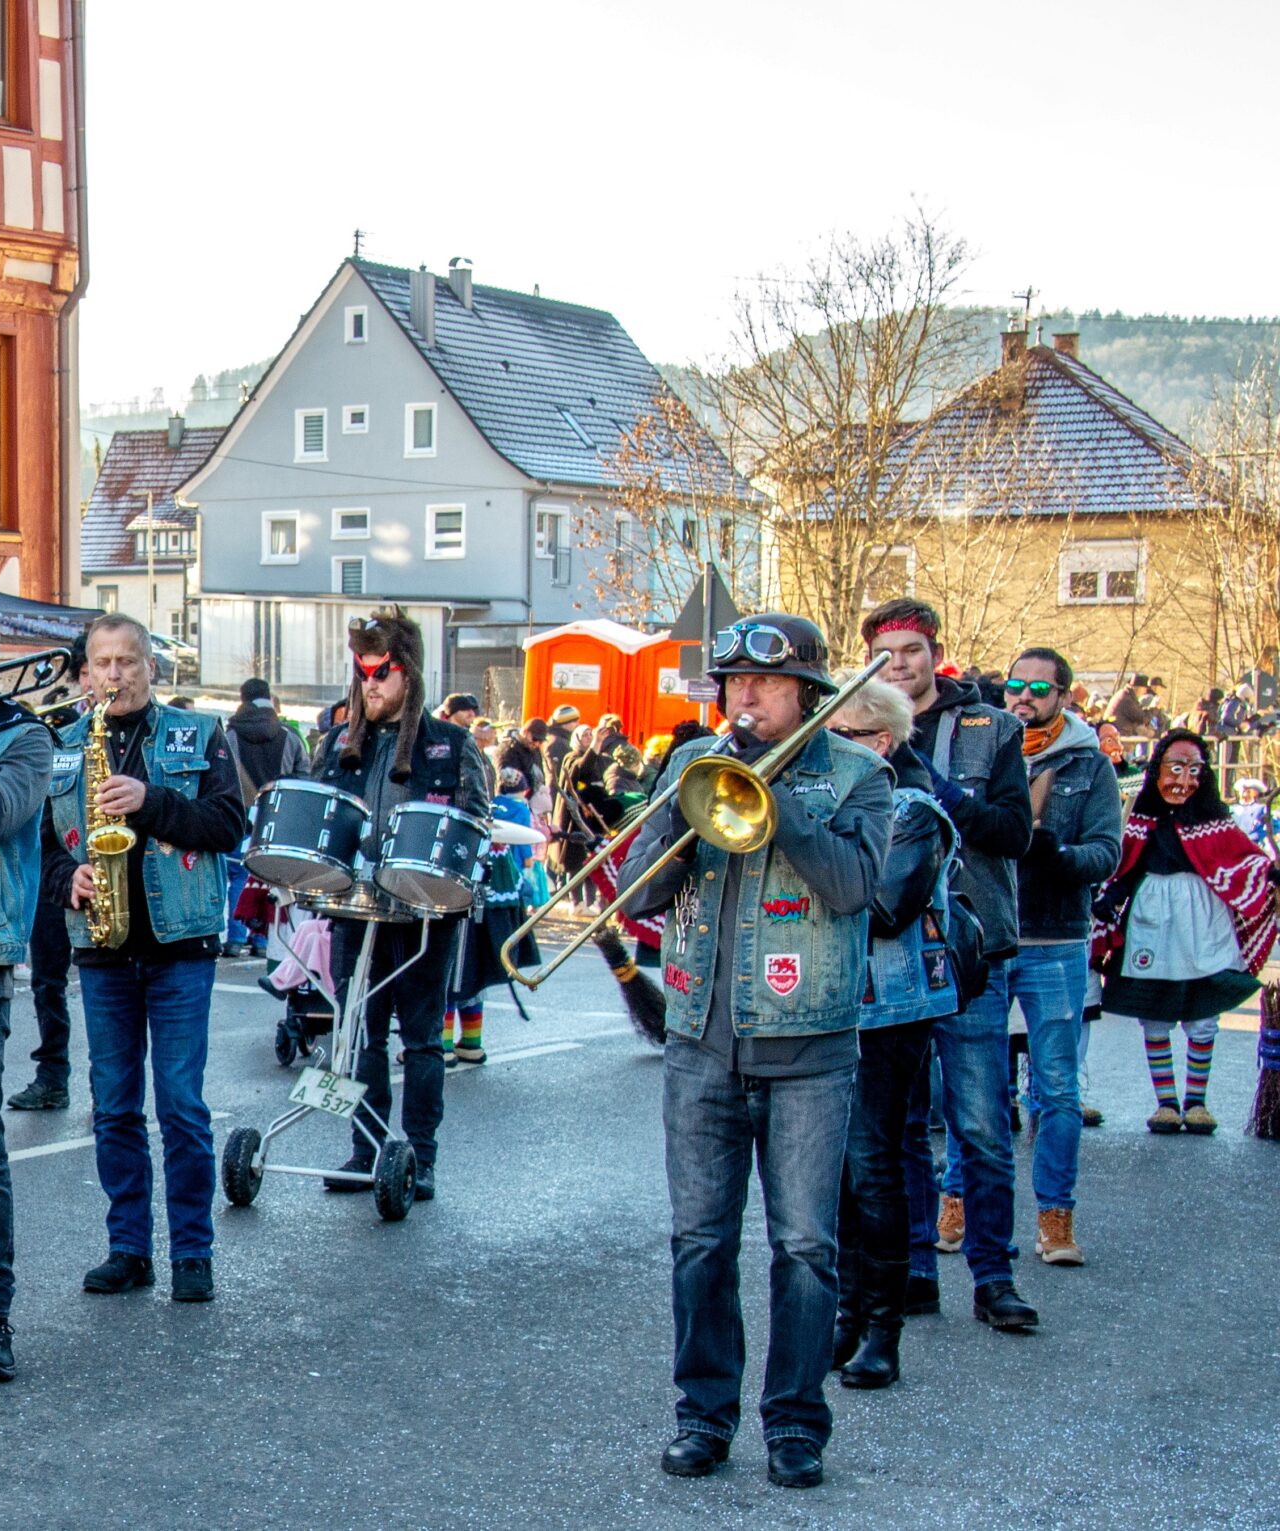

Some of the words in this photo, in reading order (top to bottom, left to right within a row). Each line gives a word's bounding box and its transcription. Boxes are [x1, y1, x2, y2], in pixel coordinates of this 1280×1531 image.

[763, 896, 810, 917] WOW!
[665, 962, 691, 996] AC/DC
[318, 1072, 337, 1093] BL
[293, 1085, 306, 1102] A
[320, 1093, 354, 1114] 537
